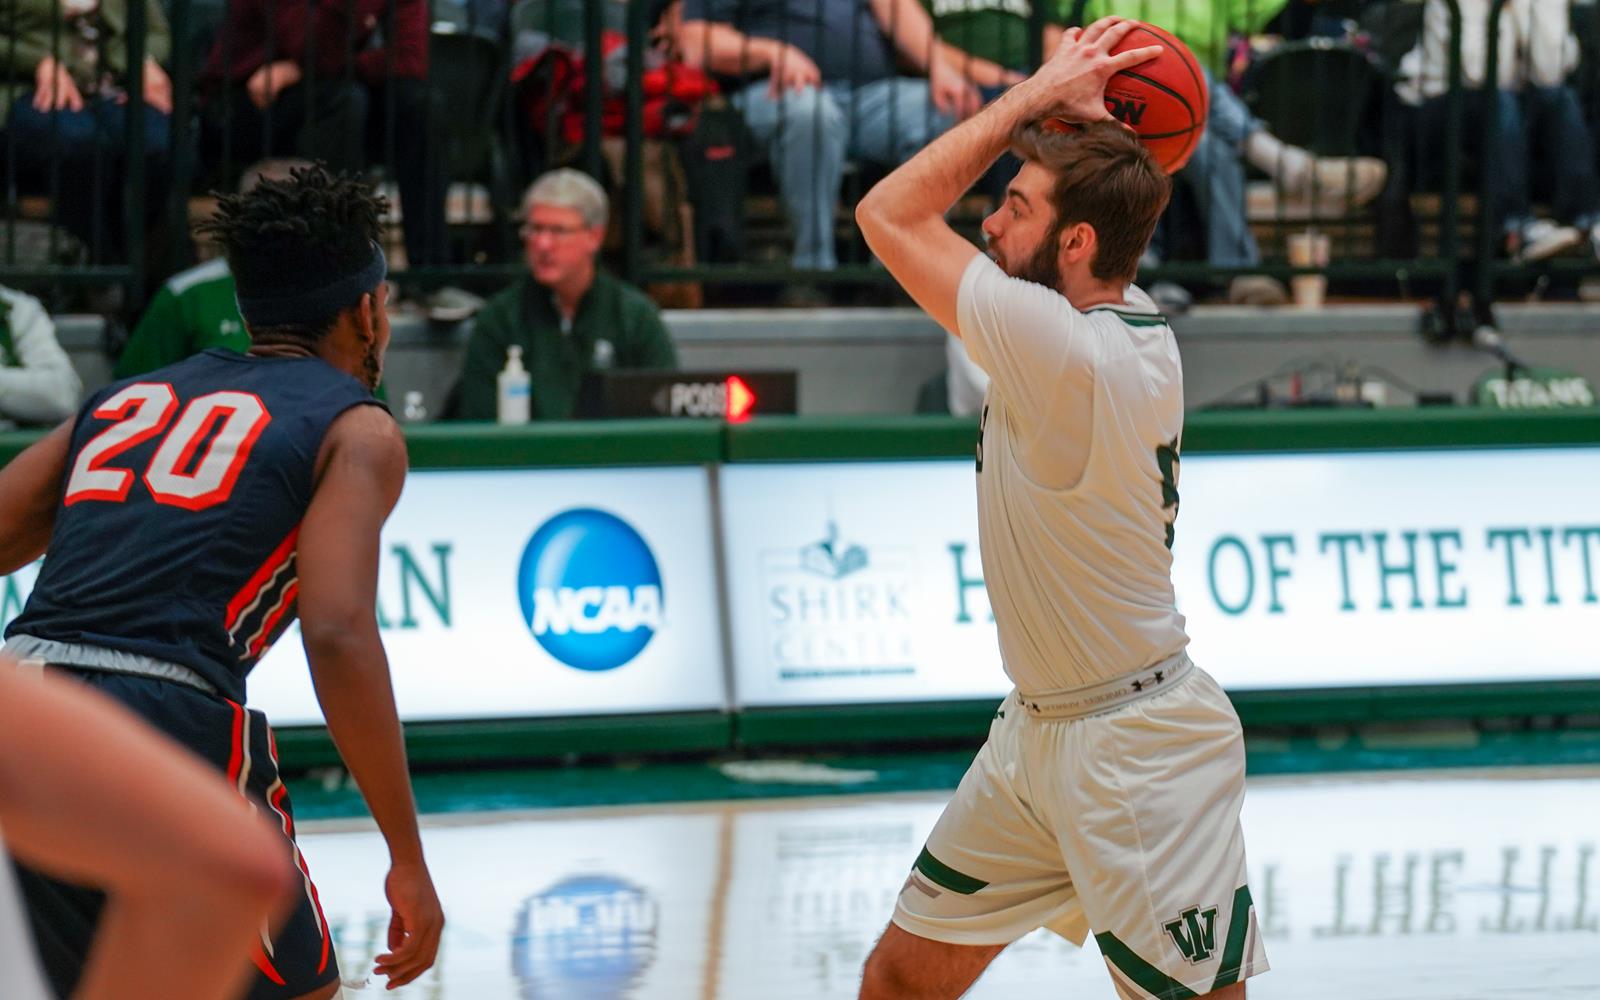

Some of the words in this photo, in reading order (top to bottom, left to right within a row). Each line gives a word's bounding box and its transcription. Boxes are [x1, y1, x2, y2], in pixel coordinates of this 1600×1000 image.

[1485, 378, 1594, 408] TITANS
[64, 382, 271, 511] 20
[1207, 532, 1296, 616] OF
[1318, 528, 1468, 611] THE
[1486, 525, 1600, 606] TIT
[532, 585, 661, 636] NCAA
[769, 583, 911, 625] SHIRK
